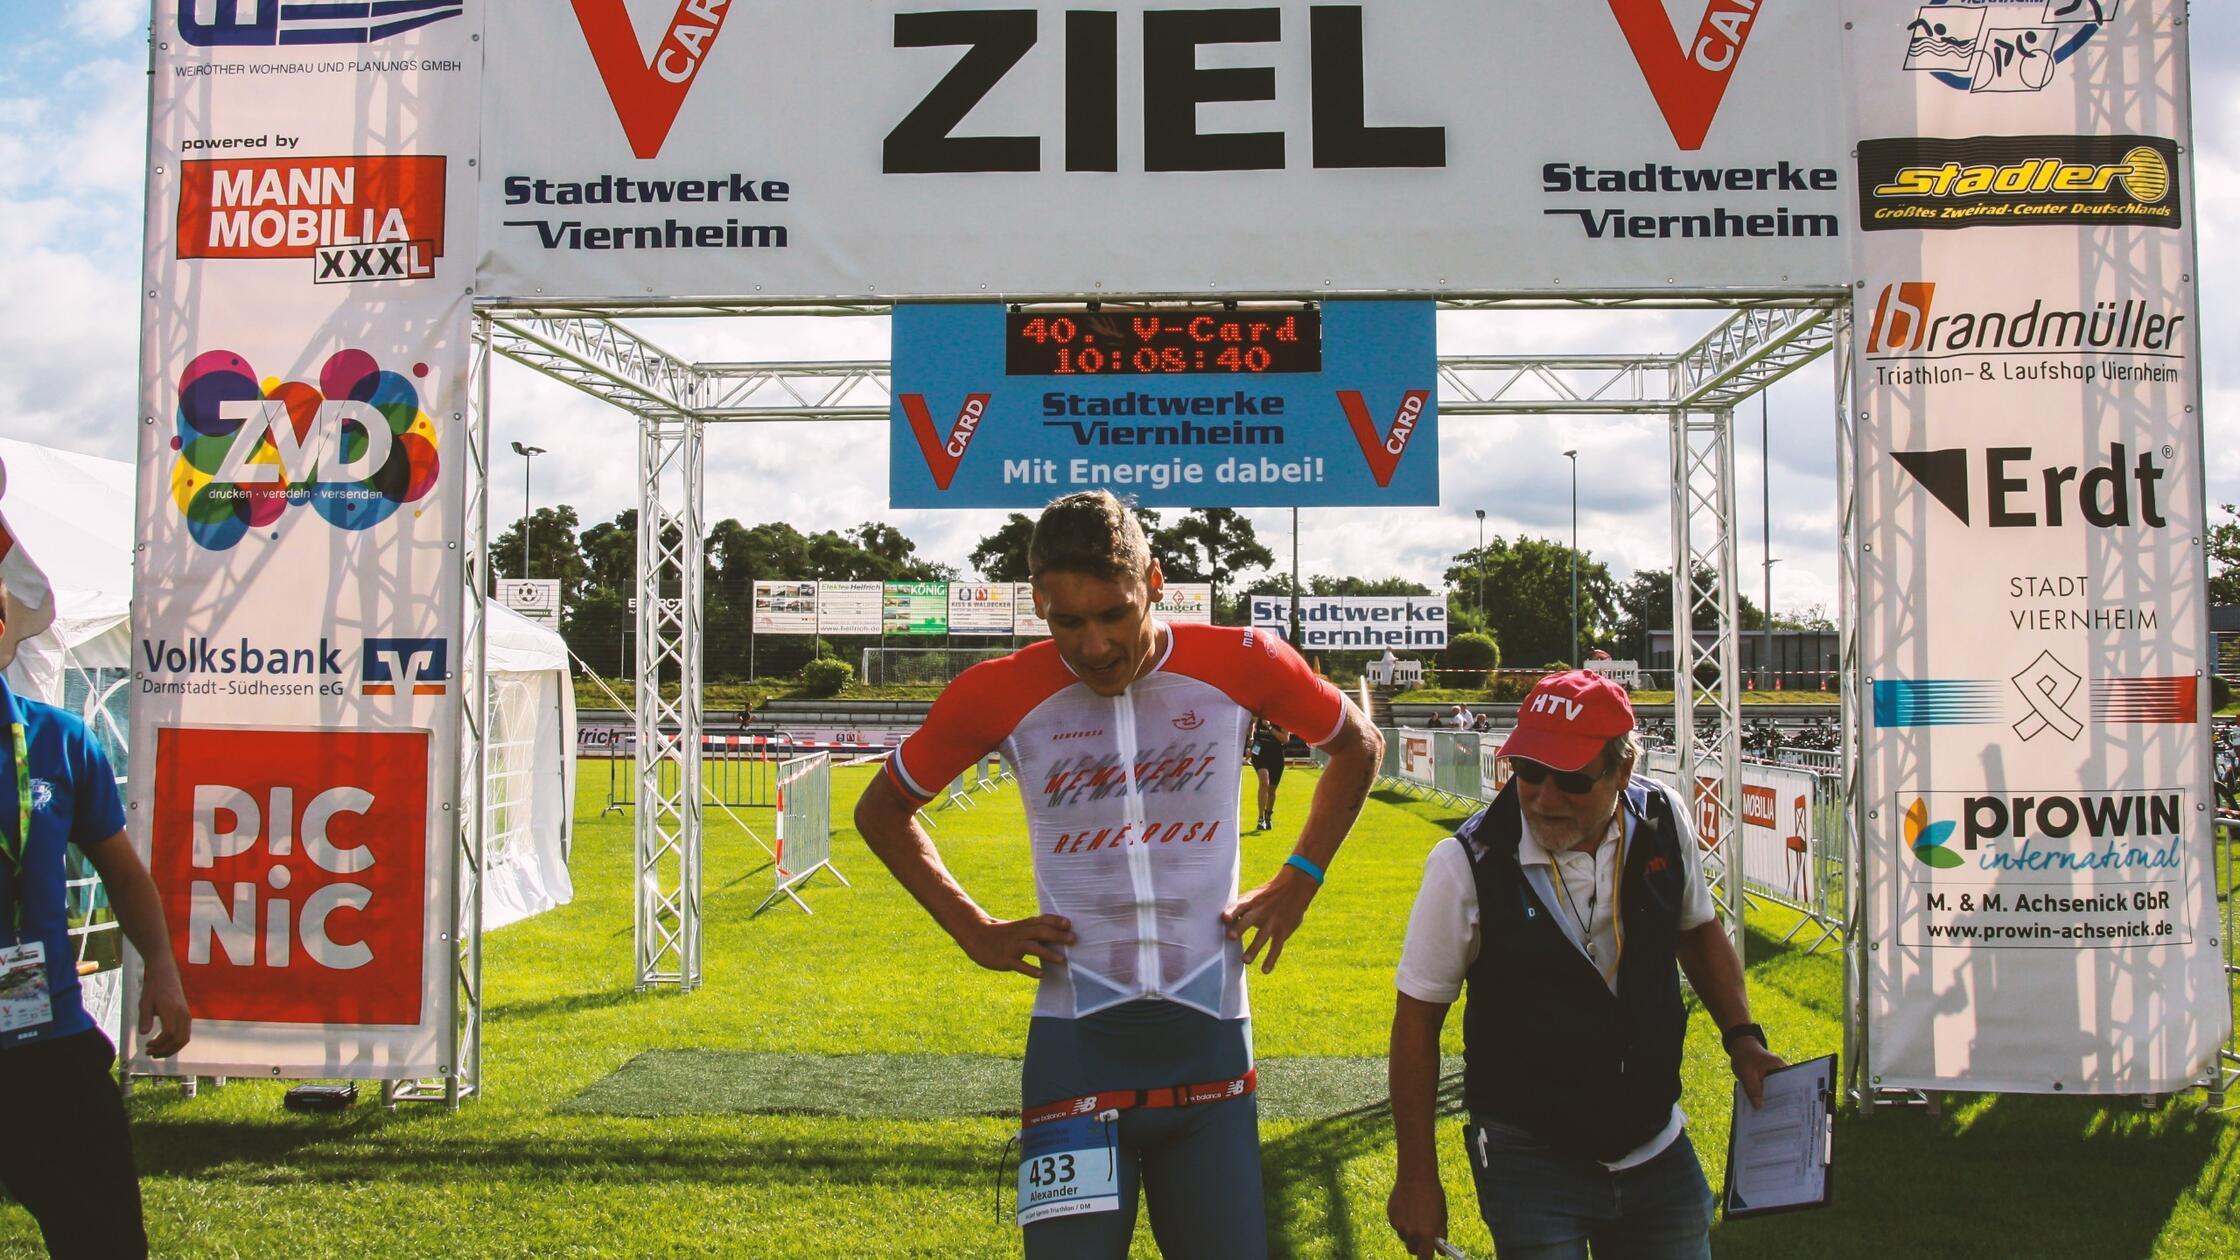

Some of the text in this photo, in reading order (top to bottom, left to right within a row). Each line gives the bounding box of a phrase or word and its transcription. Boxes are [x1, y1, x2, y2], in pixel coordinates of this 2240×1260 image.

[176, 60, 462, 77] WEIRÖTHER WOHNBAU UND PLANUNGS GMBH
[882, 5, 1446, 174] ZIEL
[181, 134, 299, 152] powered by
[211, 167, 355, 208] MANN
[504, 173, 790, 205] Stadtwerke
[1543, 161, 1838, 192] Stadtwerke
[1543, 207, 1839, 239] Viernheim
[1874, 202, 2171, 220] Größtes Zweirad-Center Deutschlands
[208, 207, 411, 248] MOBILIA
[503, 218, 788, 250] Viernheim
[319, 245, 430, 280] XXXL
[1023, 316, 1298, 344] 40. V-Card
[1866, 282, 2185, 353] brandmüller
[1054, 346, 1272, 373] 10:08:40
[1876, 360, 2178, 386] Triathlon- & Laufshop Viernheim
[1043, 391, 1284, 417] Stadtwerke
[946, 397, 985, 459] CARD
[1043, 420, 1284, 446] Viernheim
[1386, 394, 1423, 456] CARD
[211, 400, 393, 483] ZVD
[1003, 456, 1325, 490] Mit Energie dabei!
[1986, 442, 2166, 528] Erdt
[209, 487, 383, 500] drucken veredeln versenden
[910, 582, 945, 596] KÖNIG
[2010, 576, 2089, 598] STADT
[1155, 602, 1202, 613] Bugert
[2010, 609, 2158, 630] VIERNHEIM
[143, 637, 344, 675] Volksbank
[142, 678, 344, 696] Darmstadt-Südhessen eG
[1530, 693, 1584, 721] HTV
[1742, 792, 1775, 822] MOBILIA
[1979, 836, 2181, 871] international
[1927, 890, 2170, 912] M. & M. Achsenick GbR
[1926, 921, 2173, 941] www.prowin-achsenick.de
[1029, 1154, 1076, 1187] 433
[1030, 1185, 1078, 1202] Alexander
